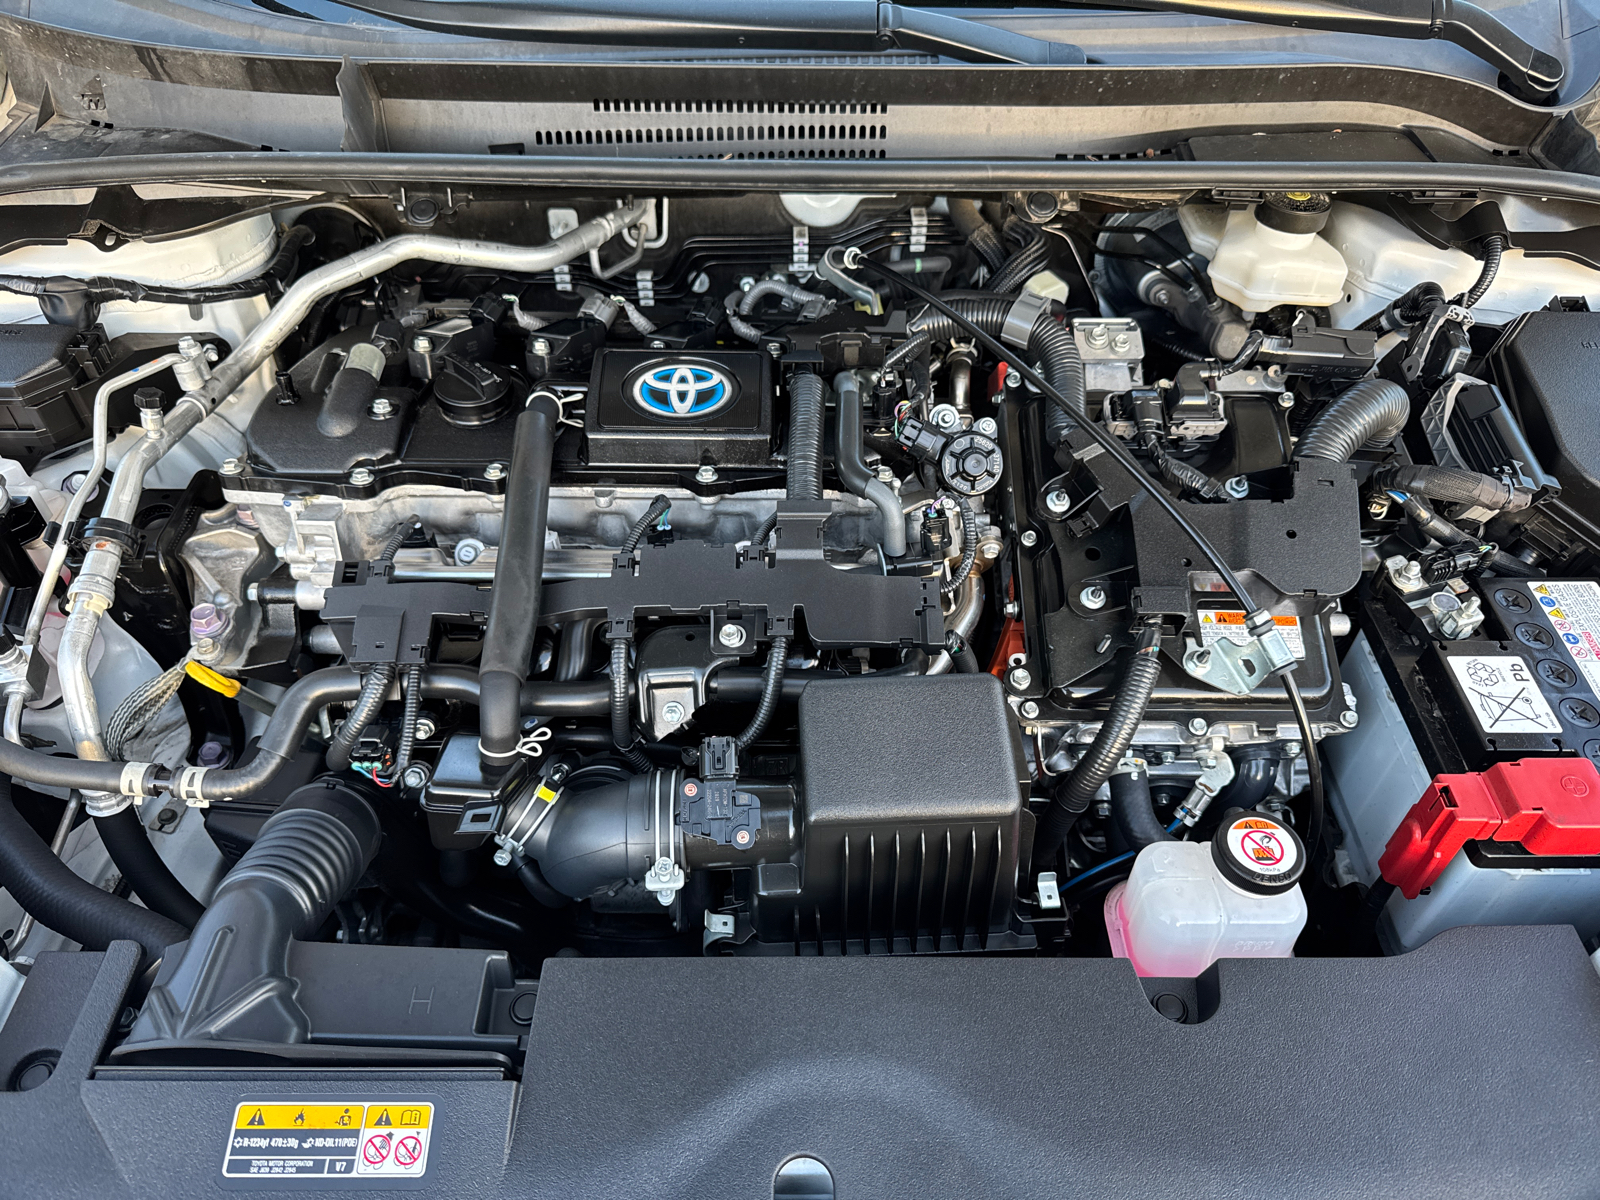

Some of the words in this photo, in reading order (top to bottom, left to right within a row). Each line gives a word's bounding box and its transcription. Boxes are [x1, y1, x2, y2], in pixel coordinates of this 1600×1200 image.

[975, 436, 993, 449] 25620
[1551, 584, 1568, 602] GASES
[1562, 601, 1588, 631] EXPLOSIVE
[1509, 663, 1530, 682] Pb
[1253, 872, 1292, 884] DENSO
[243, 1138, 270, 1149] R-1234yf
[270, 1138, 299, 1149] 470±30g
[335, 1162, 347, 1172] V7
